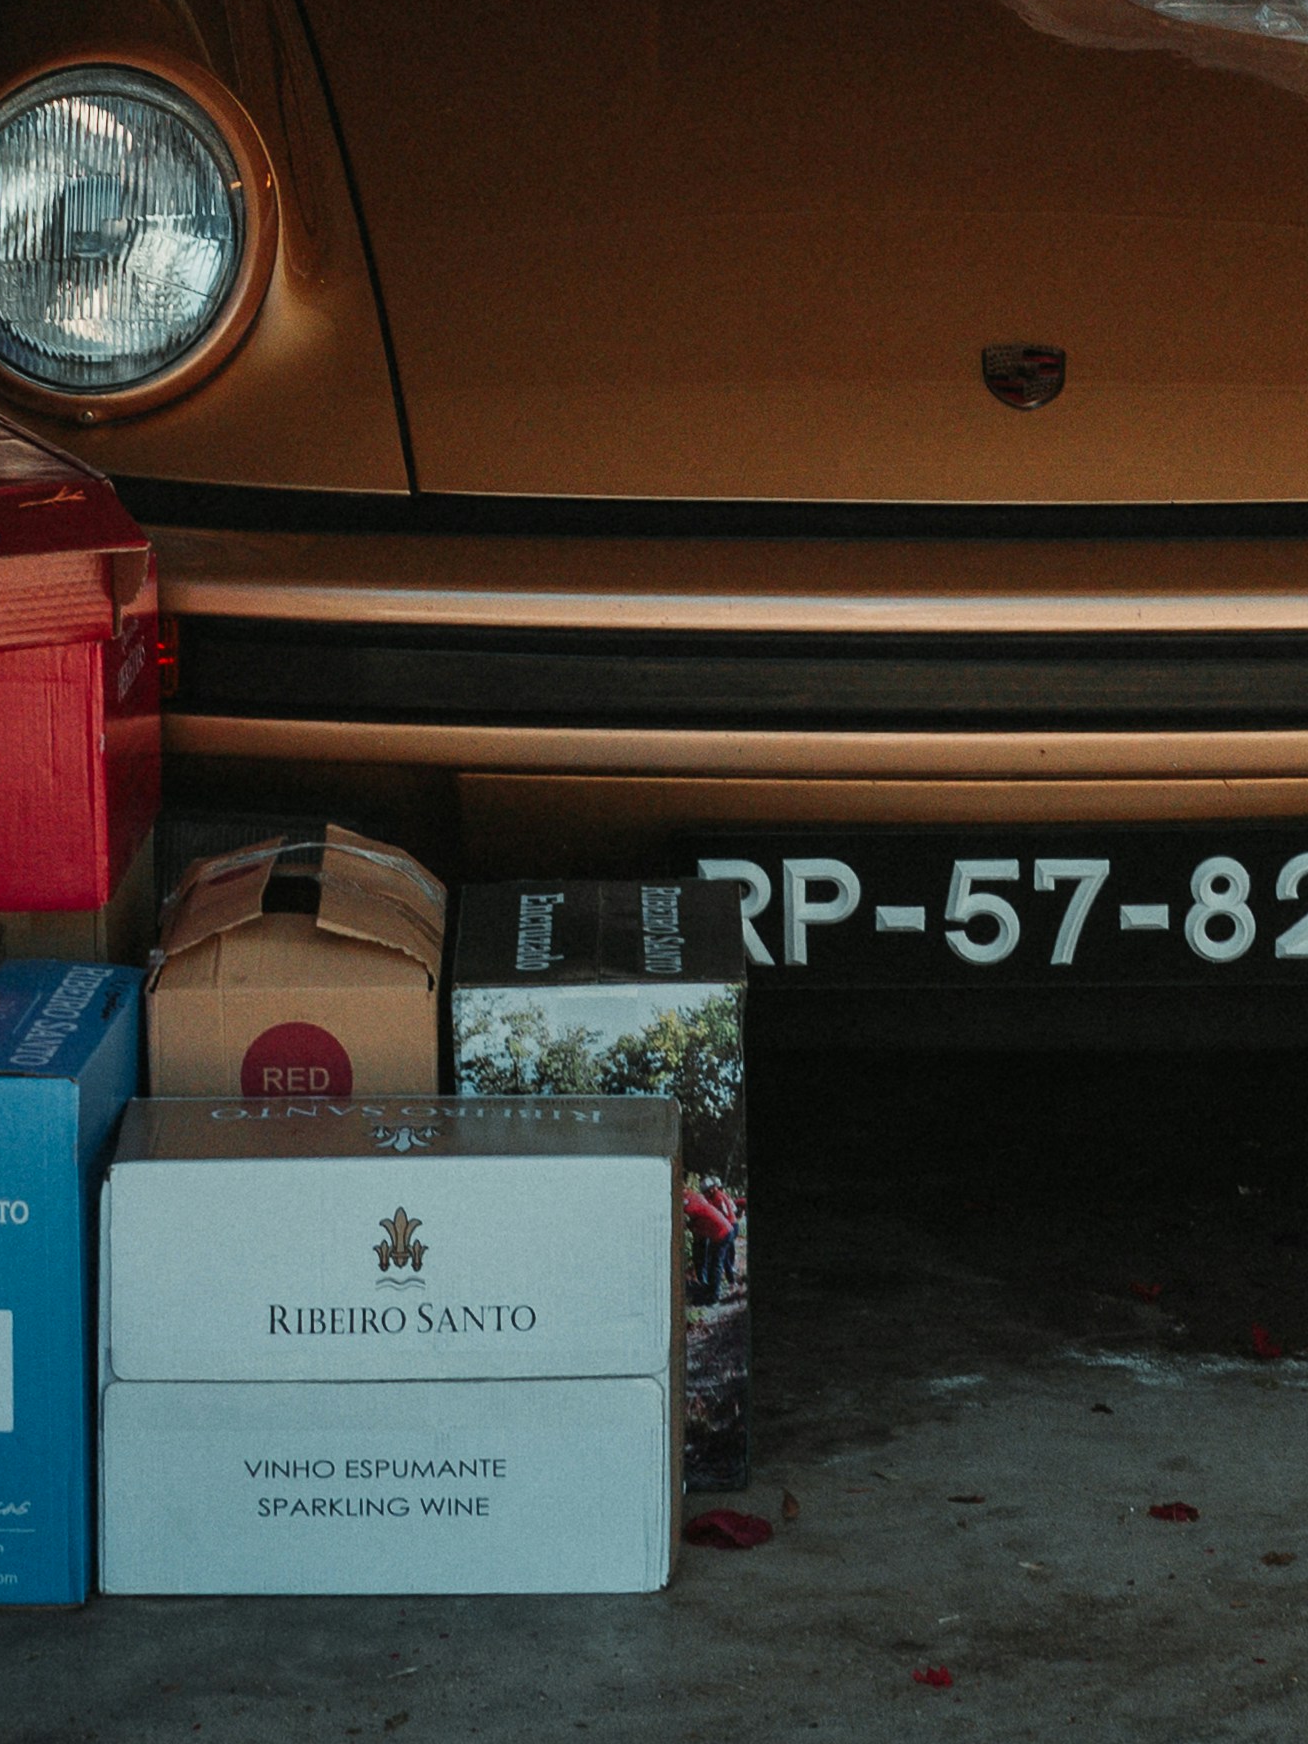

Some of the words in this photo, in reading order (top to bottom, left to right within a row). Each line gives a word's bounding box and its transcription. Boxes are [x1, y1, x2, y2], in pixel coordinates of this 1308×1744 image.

[262, 1067, 331, 1093] RED
[268, 1304, 407, 1335] RIBEIRO
[416, 1302, 537, 1334] SANTO
[243, 1459, 336, 1479] VINHO
[345, 1458, 507, 1478] ESPUMANTE
[257, 1497, 411, 1517] SPARKLING
[419, 1497, 490, 1516] WINE
